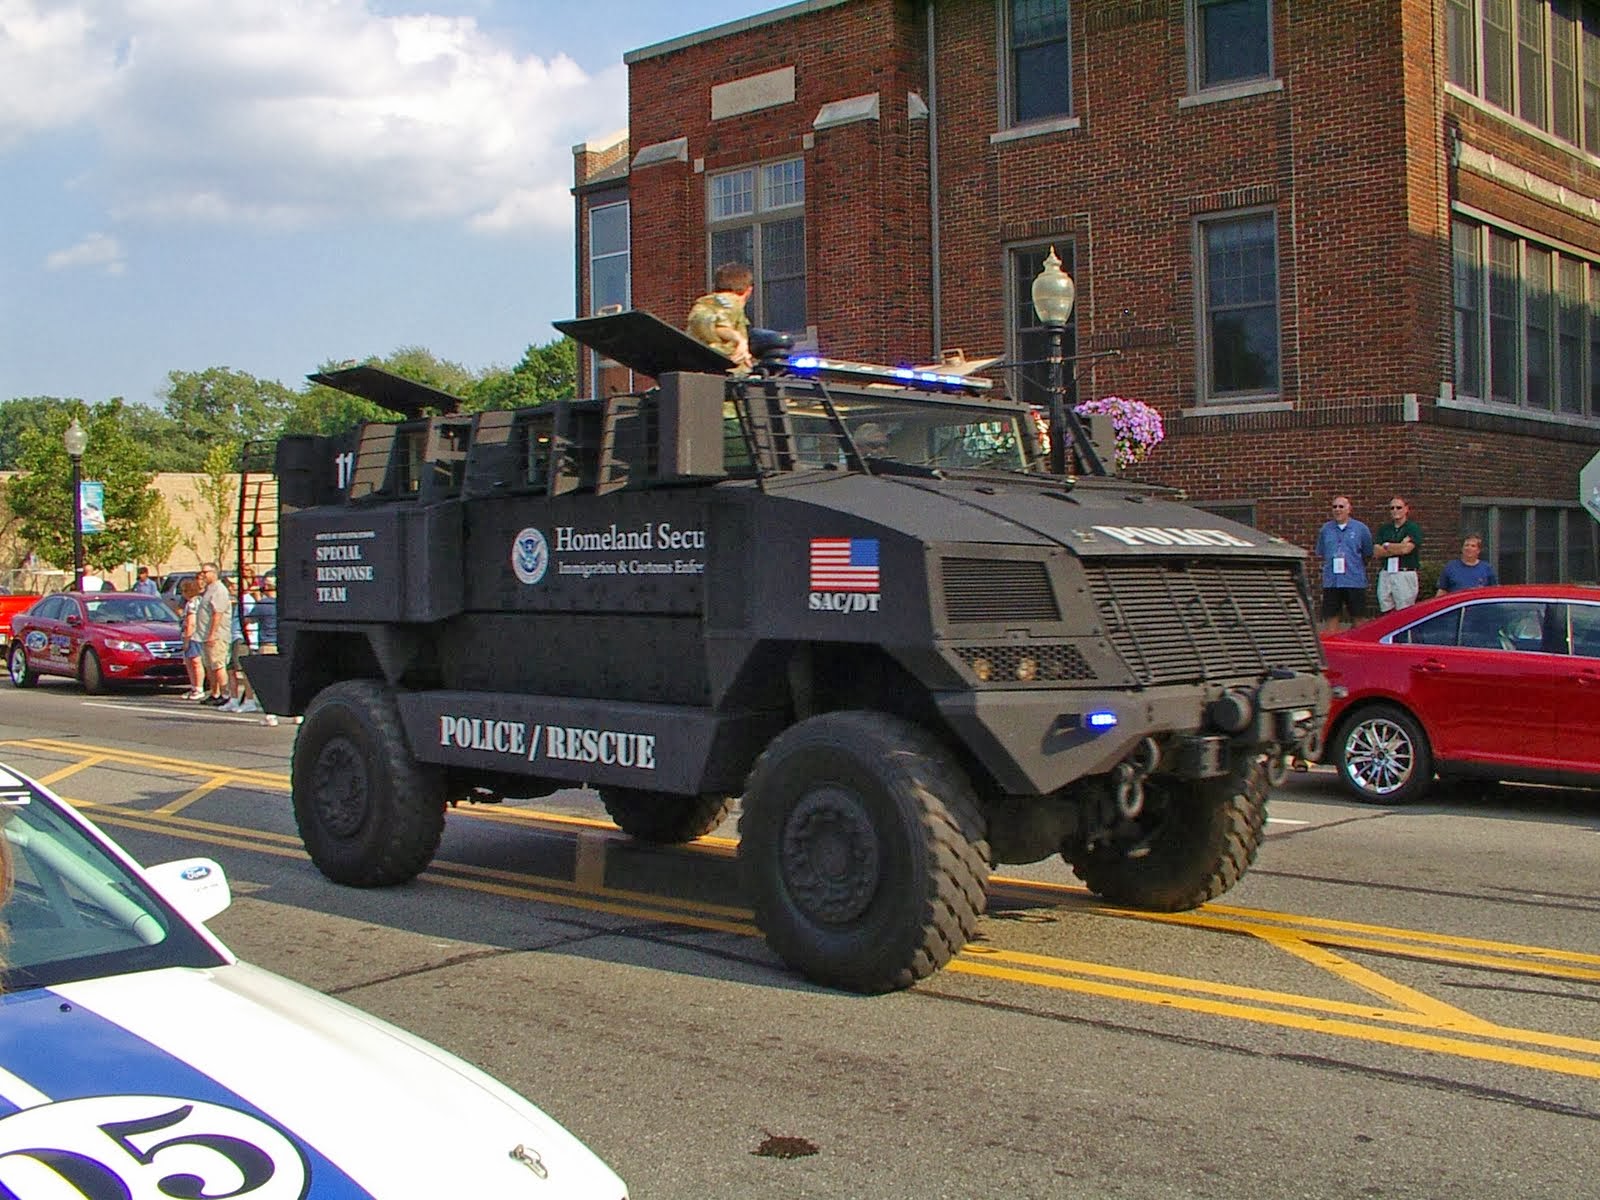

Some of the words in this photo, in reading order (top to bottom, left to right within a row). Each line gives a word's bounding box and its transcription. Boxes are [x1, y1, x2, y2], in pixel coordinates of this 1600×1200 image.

[556, 523, 652, 551] Homeland
[657, 523, 705, 550] Secu
[1091, 525, 1256, 547] POLICE
[316, 545, 362, 561] SPECIAL
[316, 566, 374, 581] RESPONSE
[618, 560, 628, 574] &
[316, 587, 347, 602] TEAM
[809, 592, 882, 614] SAC/DT
[440, 715, 525, 755] POLICE
[546, 725, 656, 769] RESCUE
